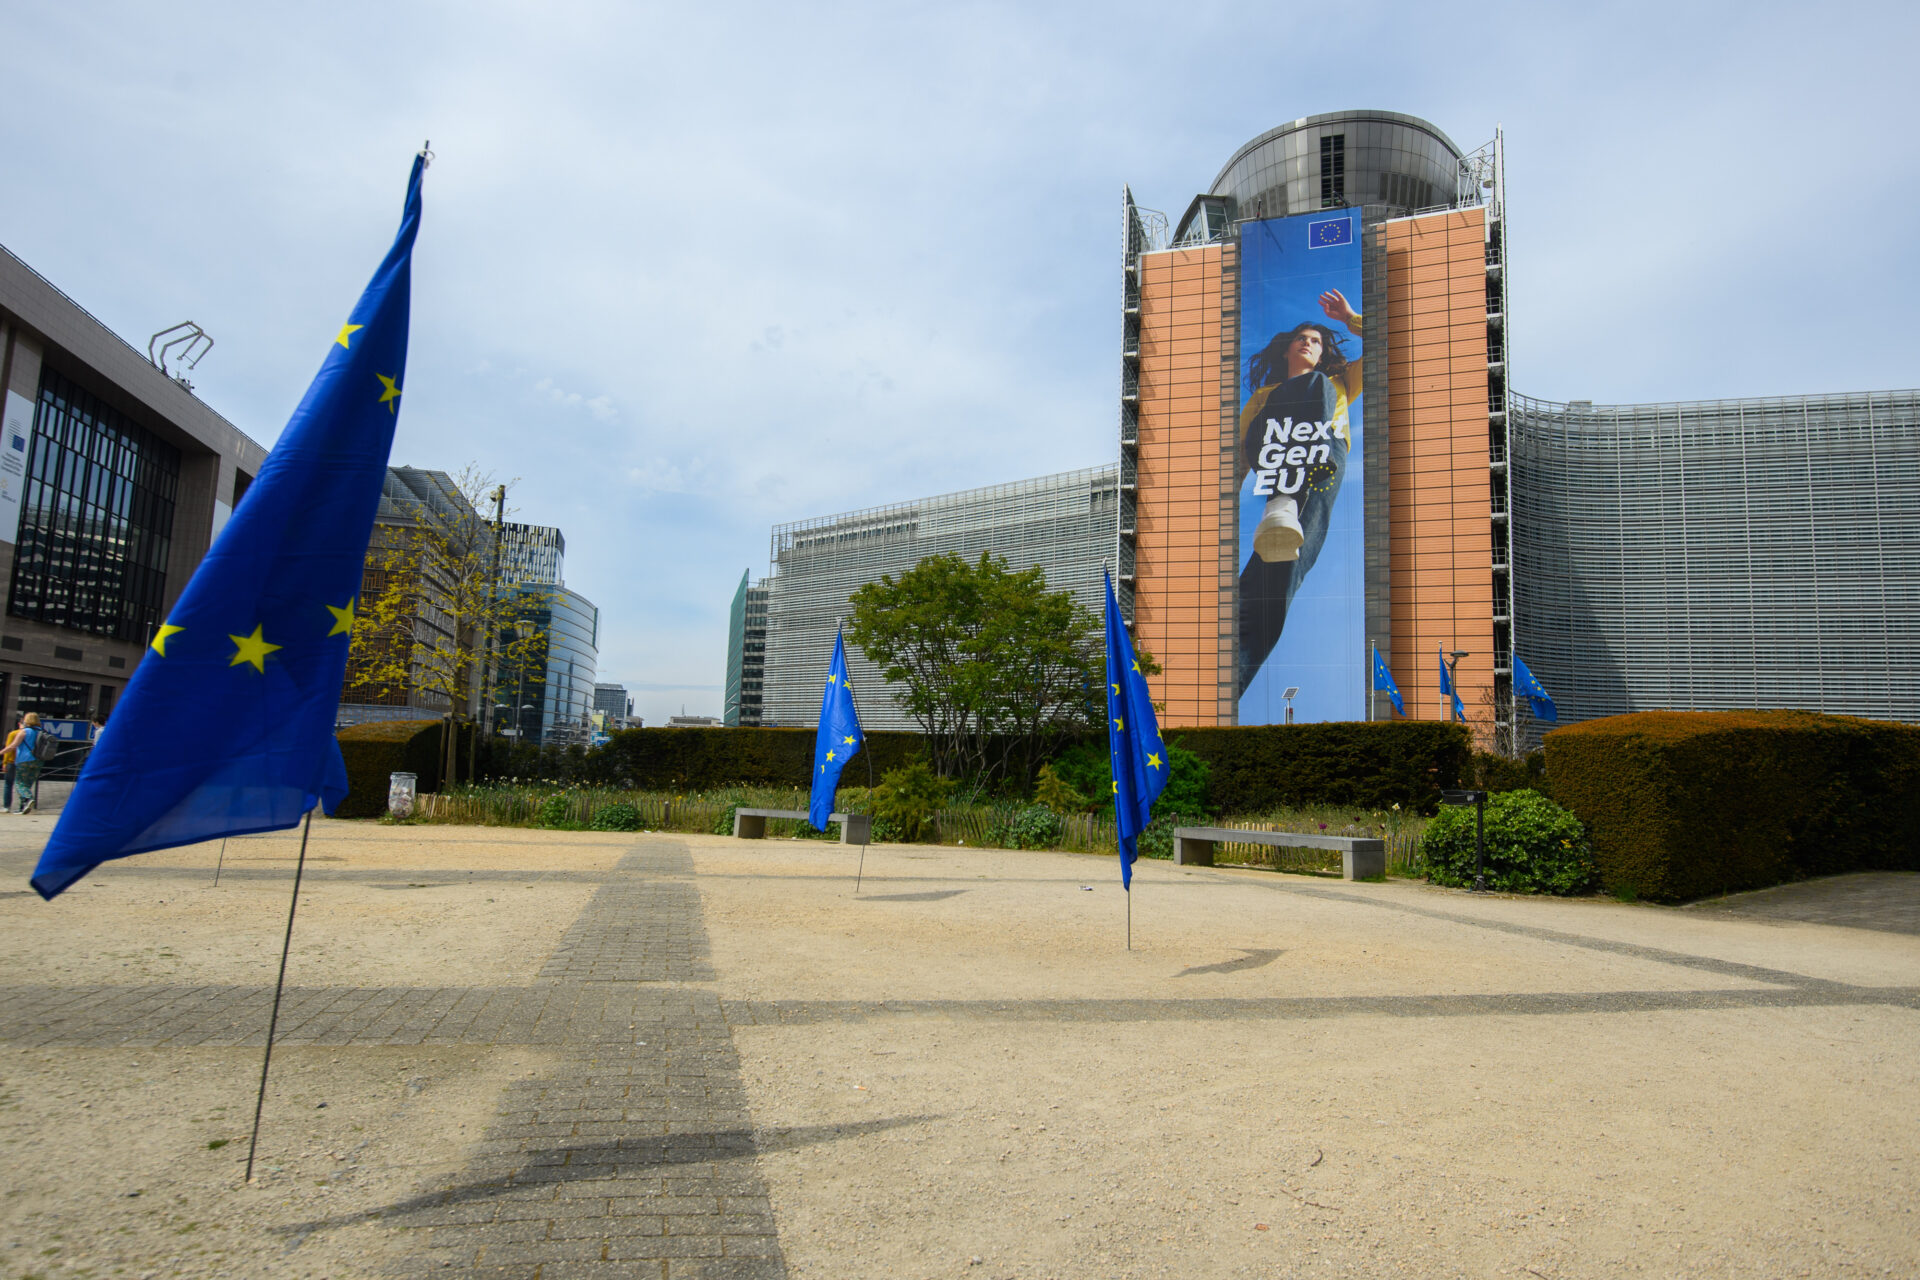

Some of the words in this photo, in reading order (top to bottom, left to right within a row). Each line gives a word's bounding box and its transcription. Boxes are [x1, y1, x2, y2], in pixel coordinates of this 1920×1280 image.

[1263, 415, 1347, 444] Next
[1258, 443, 1330, 469] Gen
[1253, 467, 1306, 496] EU
